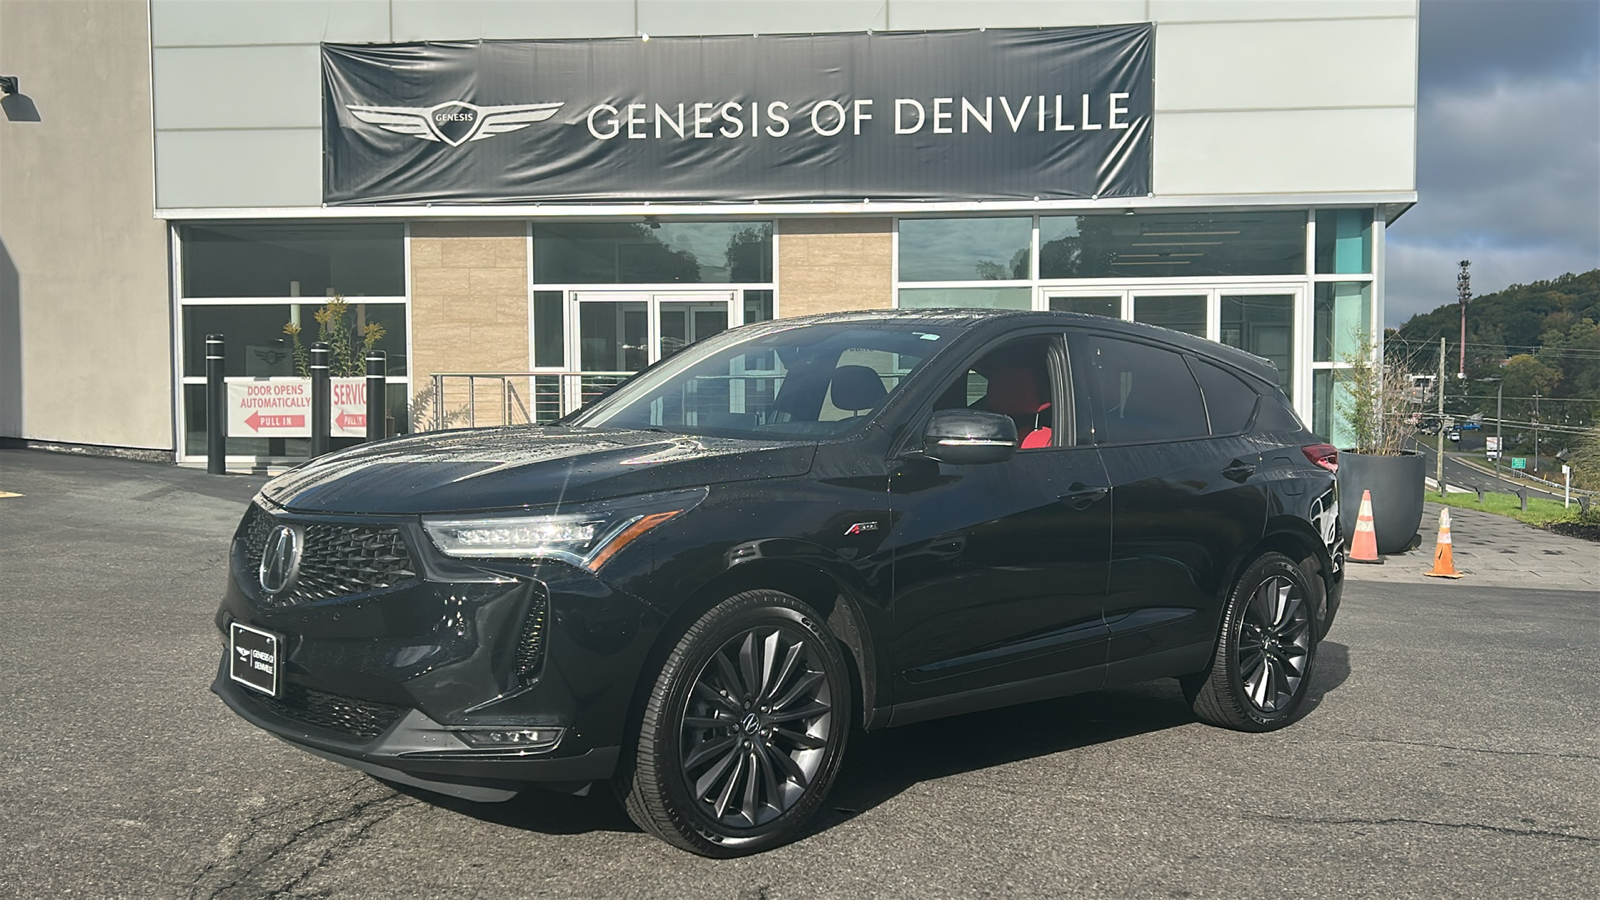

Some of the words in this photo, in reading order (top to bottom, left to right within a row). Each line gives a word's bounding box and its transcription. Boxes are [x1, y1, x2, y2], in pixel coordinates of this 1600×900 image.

[435, 113, 474, 122] GENESIS
[587, 101, 791, 140] GENESIS
[810, 99, 874, 137] OF
[894, 92, 1130, 135] DENVILLE
[247, 386, 272, 396] DOOR
[274, 384, 304, 395] OPENS
[333, 383, 367, 405] SERVIC
[240, 397, 311, 408] AUTOMATICALLY
[260, 417, 280, 426] PULL
[282, 416, 292, 426] IN
